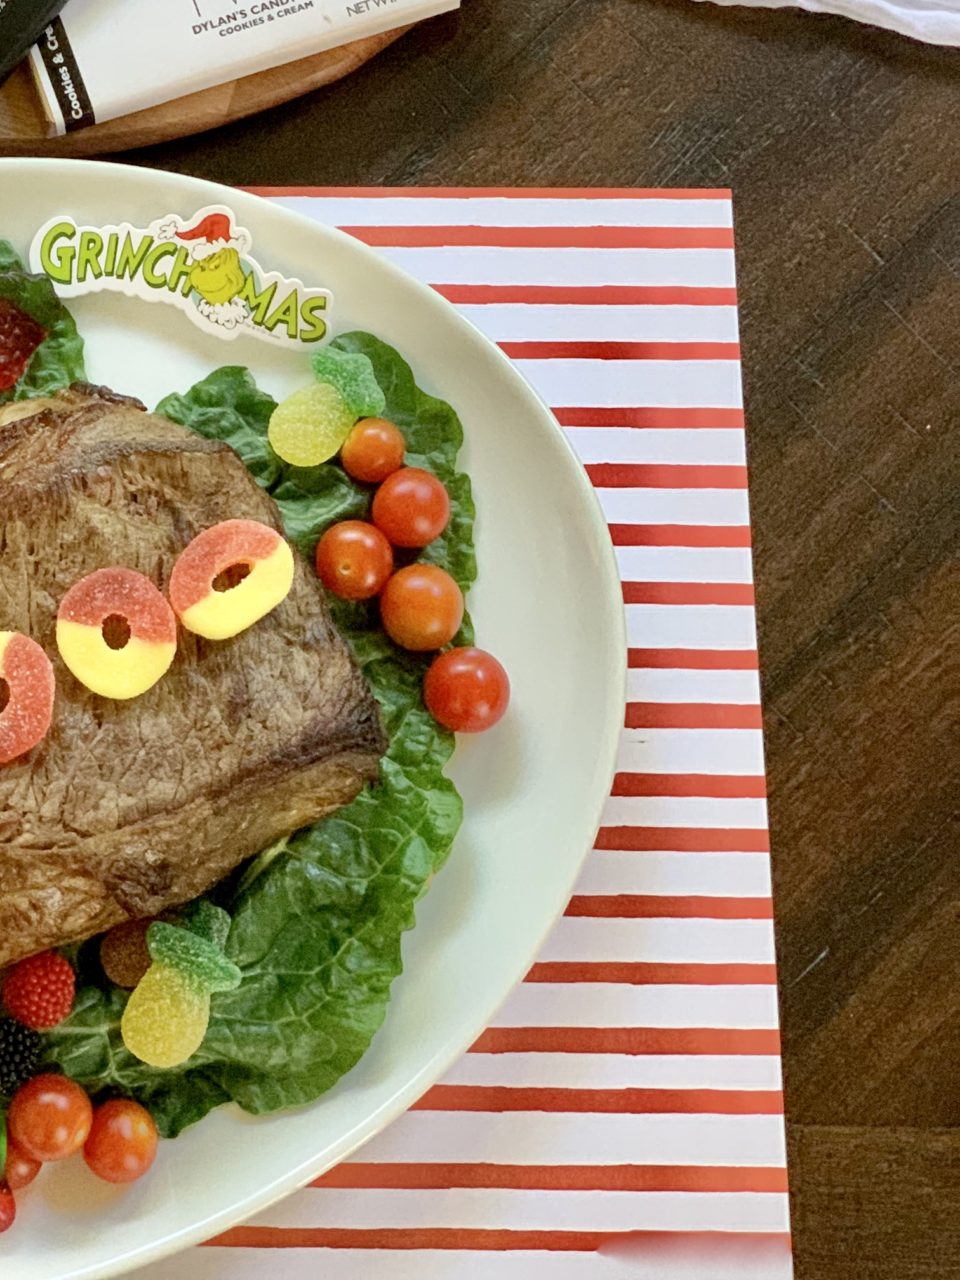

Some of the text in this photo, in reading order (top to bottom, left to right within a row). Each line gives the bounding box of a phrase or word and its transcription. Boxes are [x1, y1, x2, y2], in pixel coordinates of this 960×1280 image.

[191, 9, 248, 35] DYLAN'S
[219, 0, 314, 37] COOKIES & CREAM
[346, 2, 370, 17] NET
[44, 24, 83, 119] Cookies & Cre
